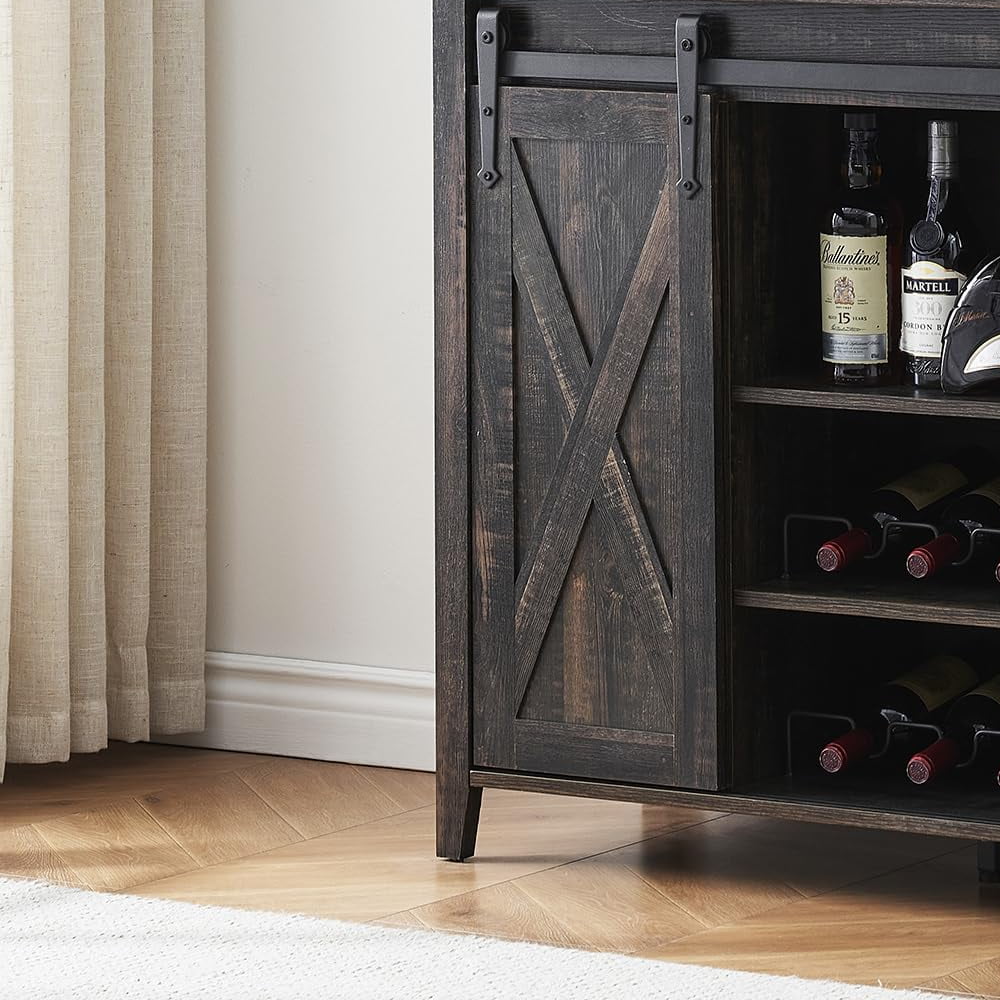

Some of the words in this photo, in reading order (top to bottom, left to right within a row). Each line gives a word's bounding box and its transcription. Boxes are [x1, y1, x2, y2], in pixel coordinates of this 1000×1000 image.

[906, 280, 951, 292] MARTELL
[838, 312, 850, 324] 15
[903, 320, 933, 331] CORDON
